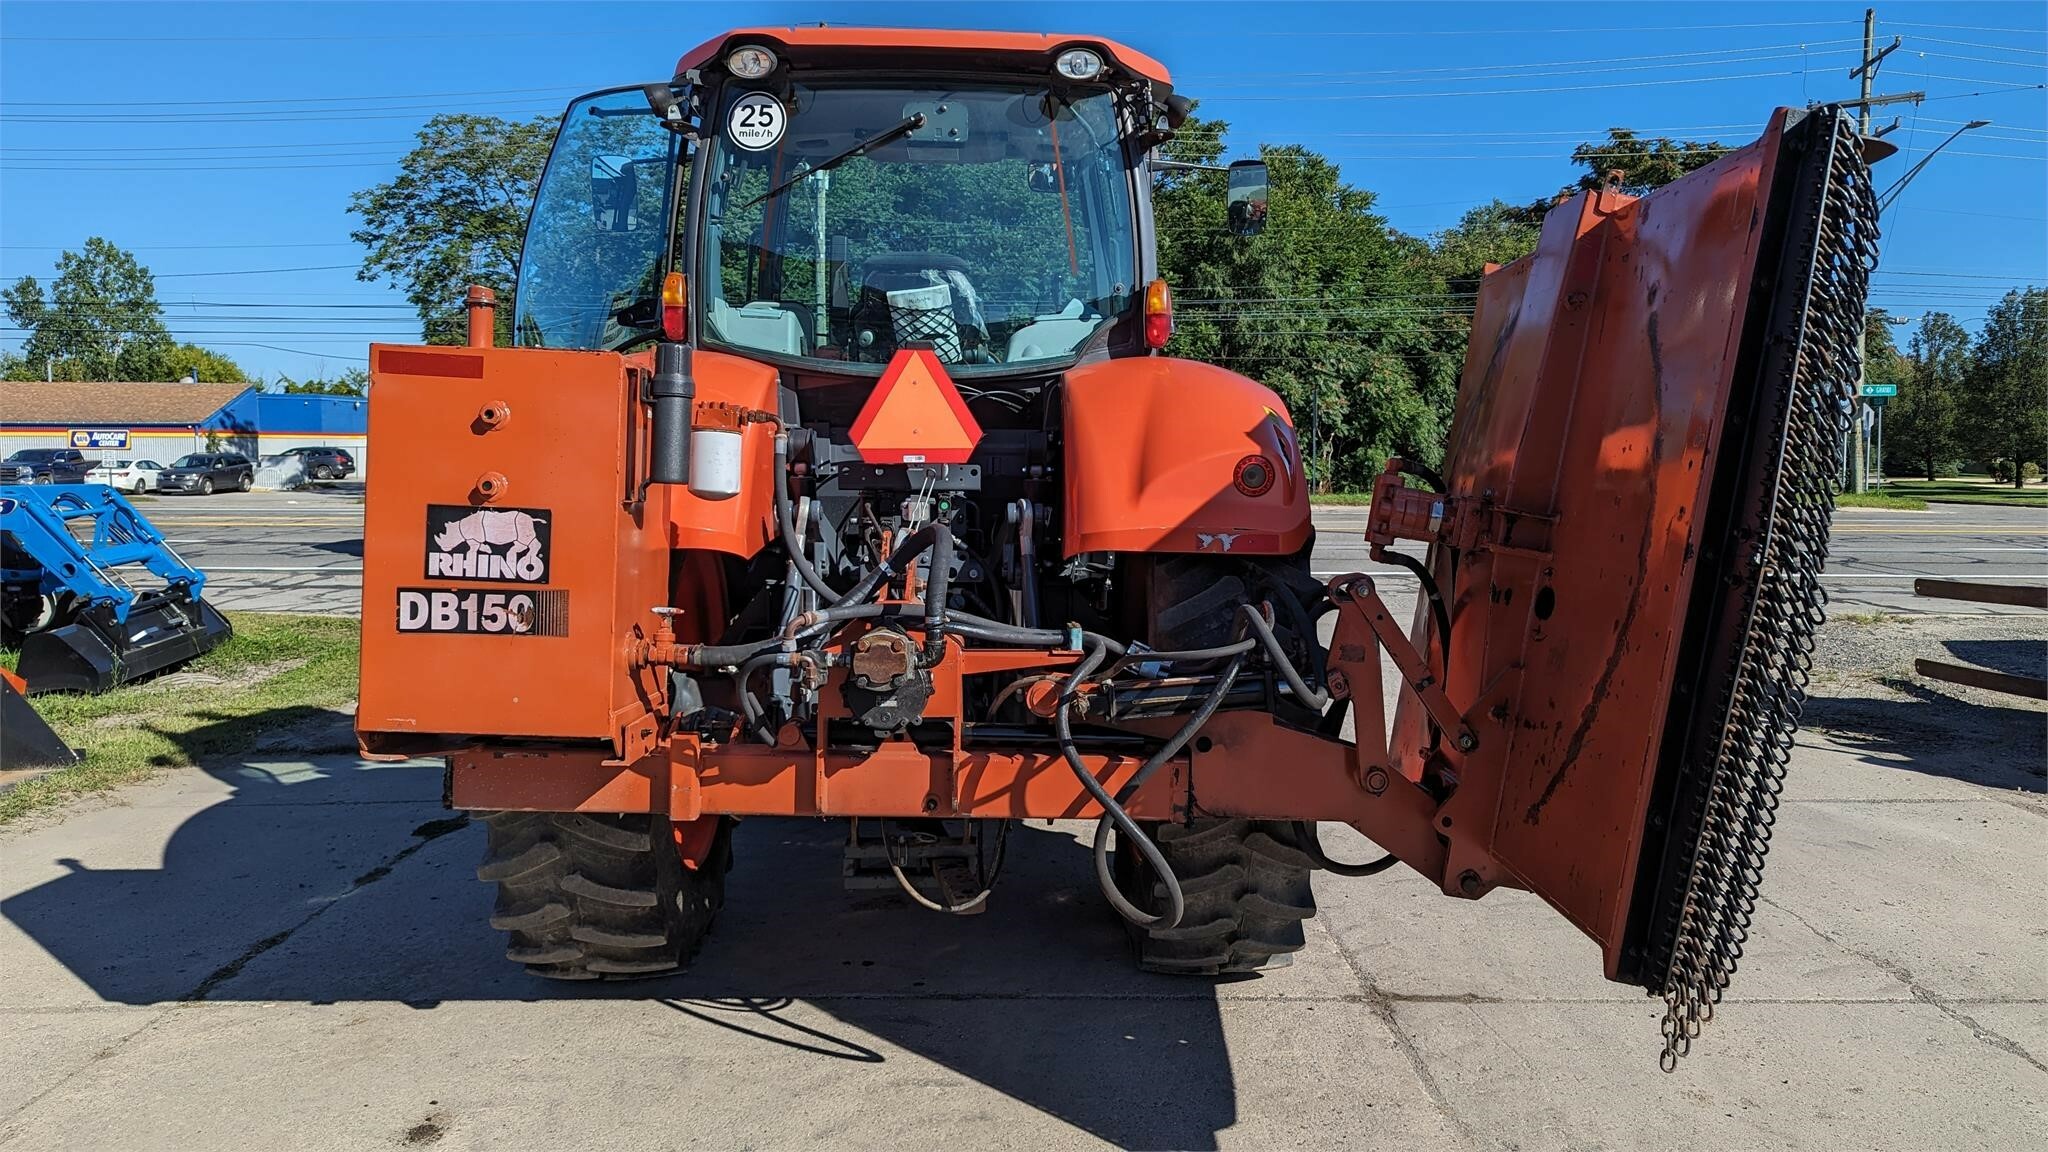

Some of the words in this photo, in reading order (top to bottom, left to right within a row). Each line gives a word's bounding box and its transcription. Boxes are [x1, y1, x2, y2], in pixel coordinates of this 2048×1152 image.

[740, 104, 774, 128] 25
[739, 129, 773, 138] mile/h
[428, 551, 545, 581] RHINO
[399, 591, 536, 633] DB150
